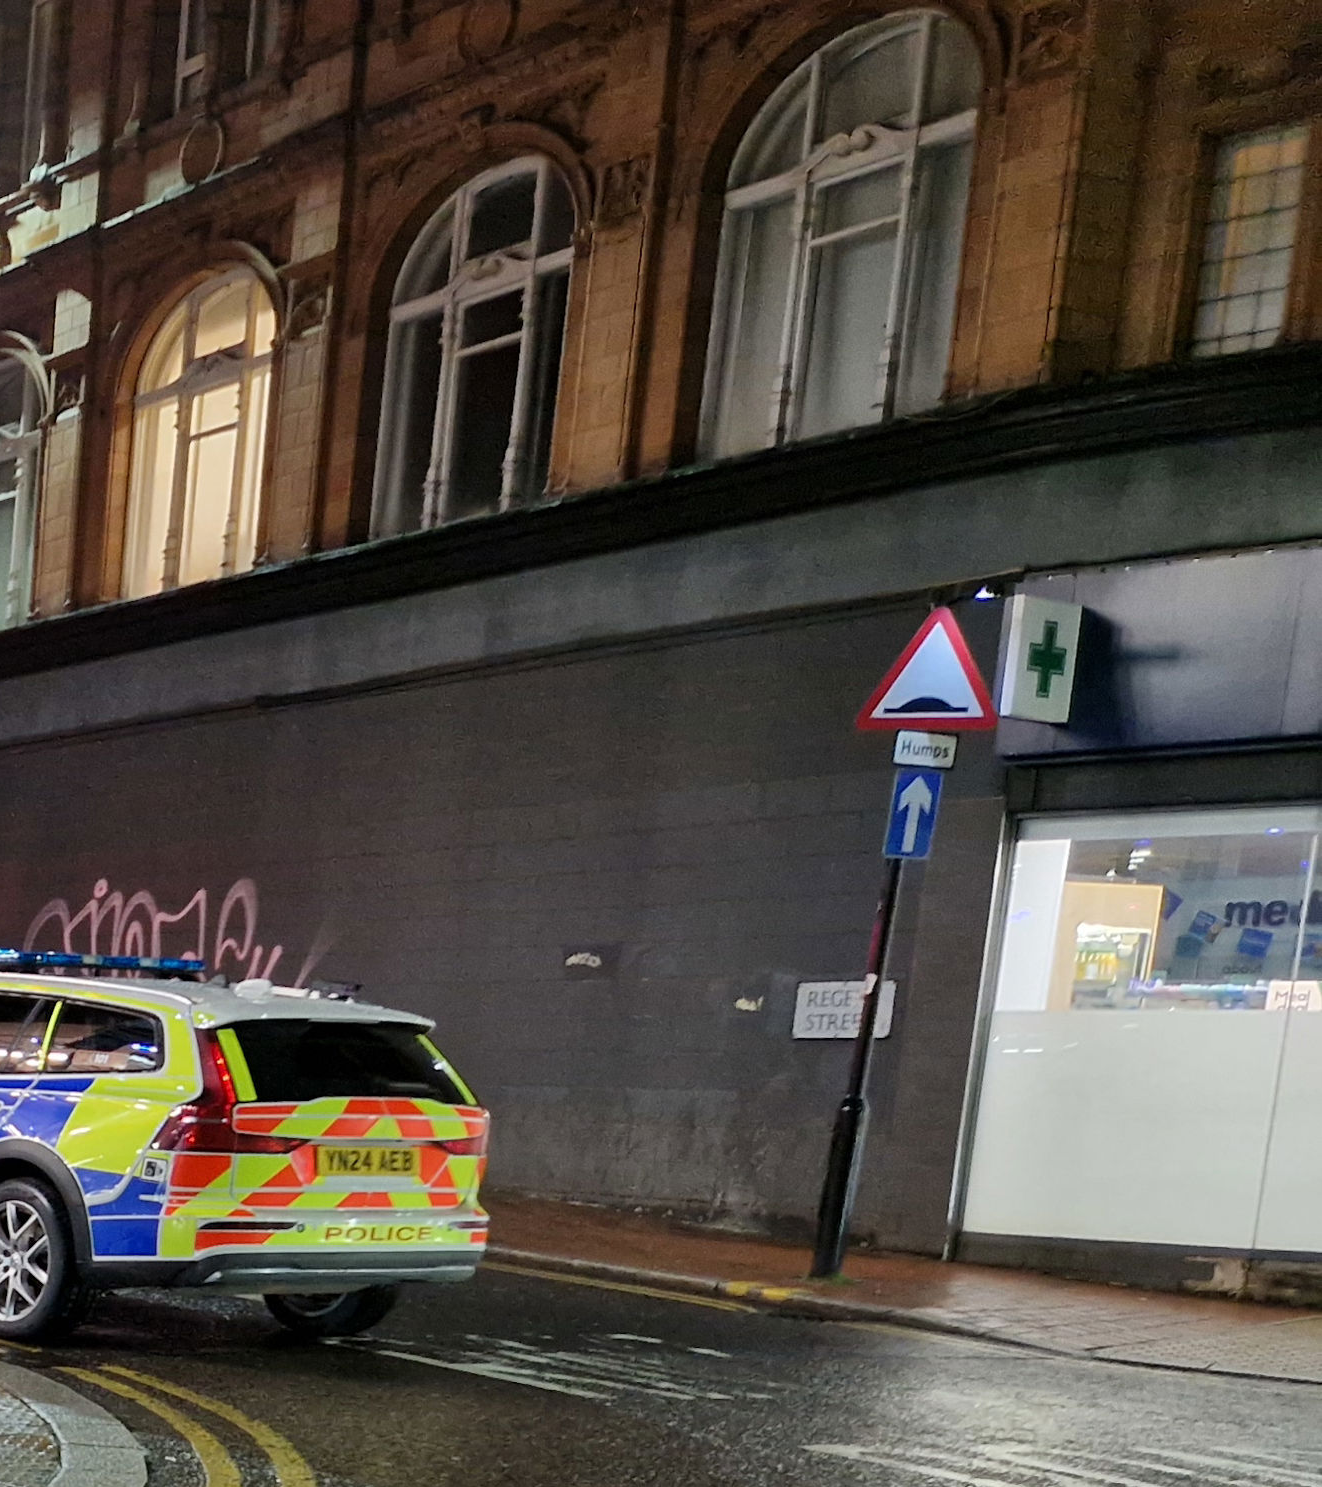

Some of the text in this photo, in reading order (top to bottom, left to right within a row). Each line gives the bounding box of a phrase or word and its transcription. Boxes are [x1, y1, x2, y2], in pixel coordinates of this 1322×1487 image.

[900, 740, 951, 759] Humps
[326, 1150, 413, 1172] YN24 AEB
[325, 1227, 433, 1242] POLICE
